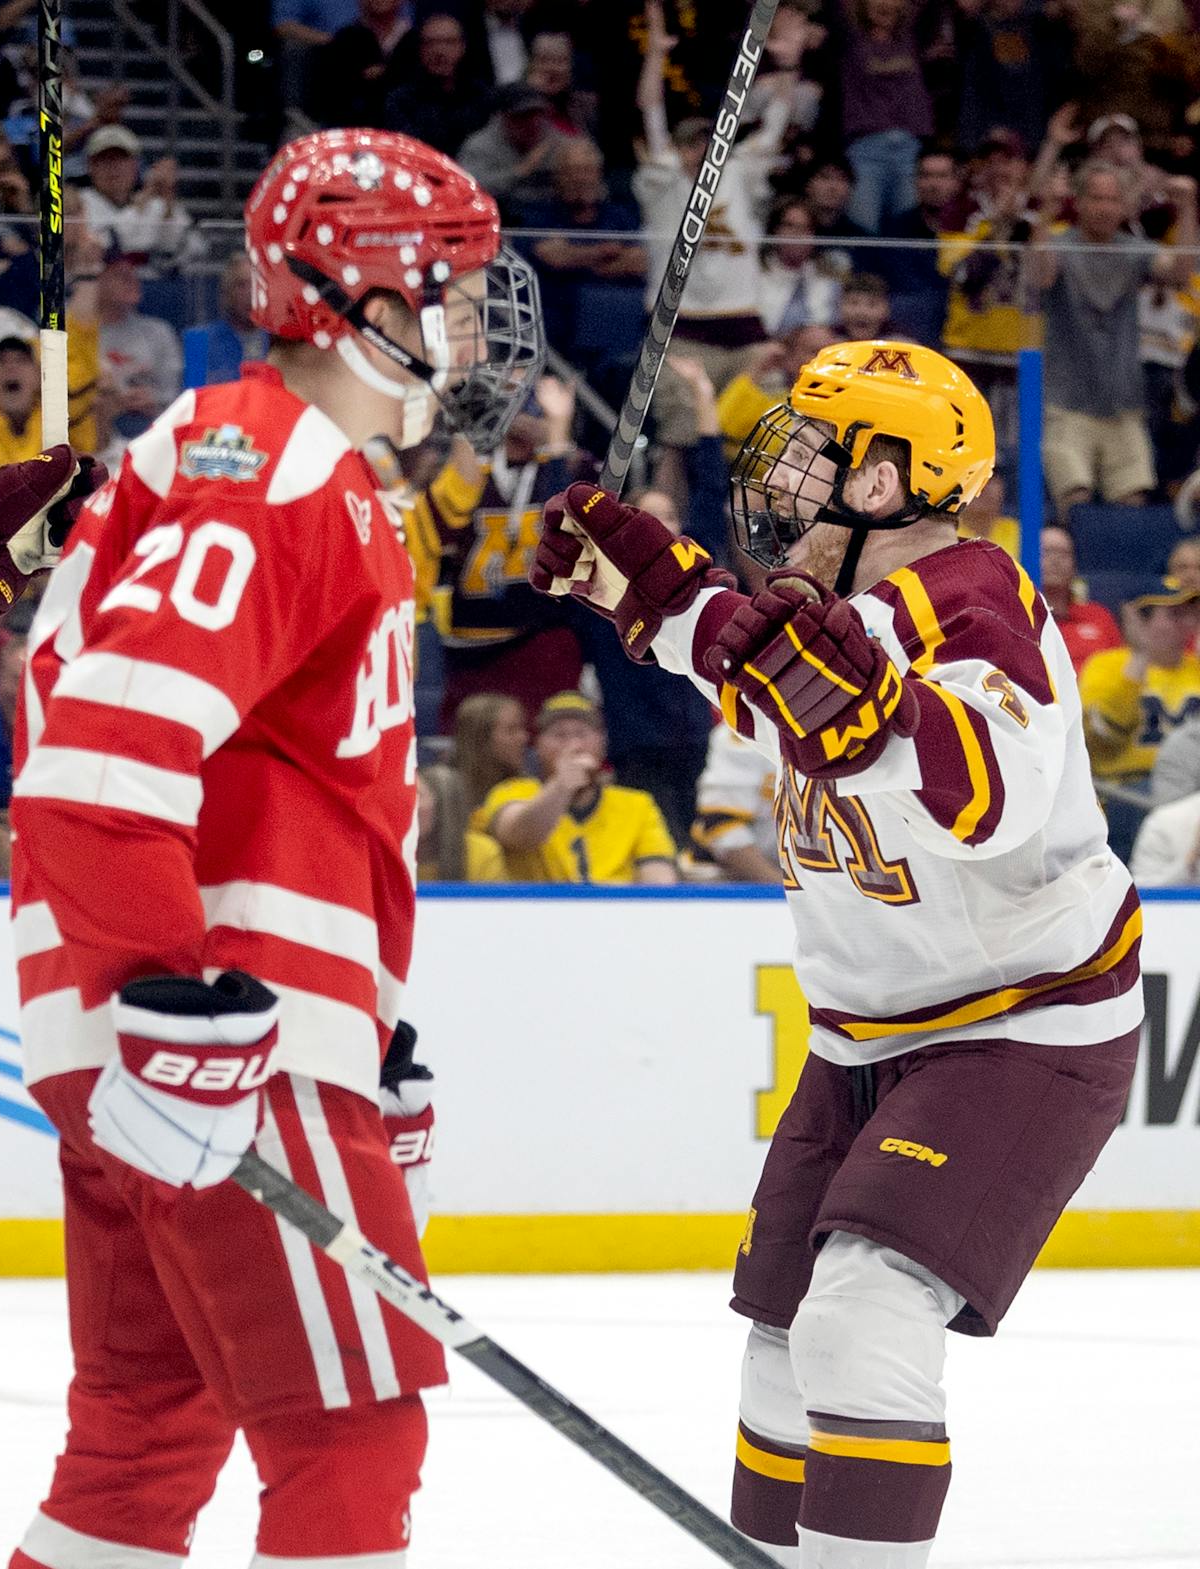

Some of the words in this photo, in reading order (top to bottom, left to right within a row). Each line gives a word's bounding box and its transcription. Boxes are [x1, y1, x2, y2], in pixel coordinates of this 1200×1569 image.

[39, 0, 64, 133] TACK
[49, 133, 63, 235] SUPER
[682, 28, 761, 245] JETSPEED
[857, 348, 919, 380] M
[97, 520, 257, 632] 20
[820, 660, 903, 761] CM
[879, 1137, 948, 1167] CCM
